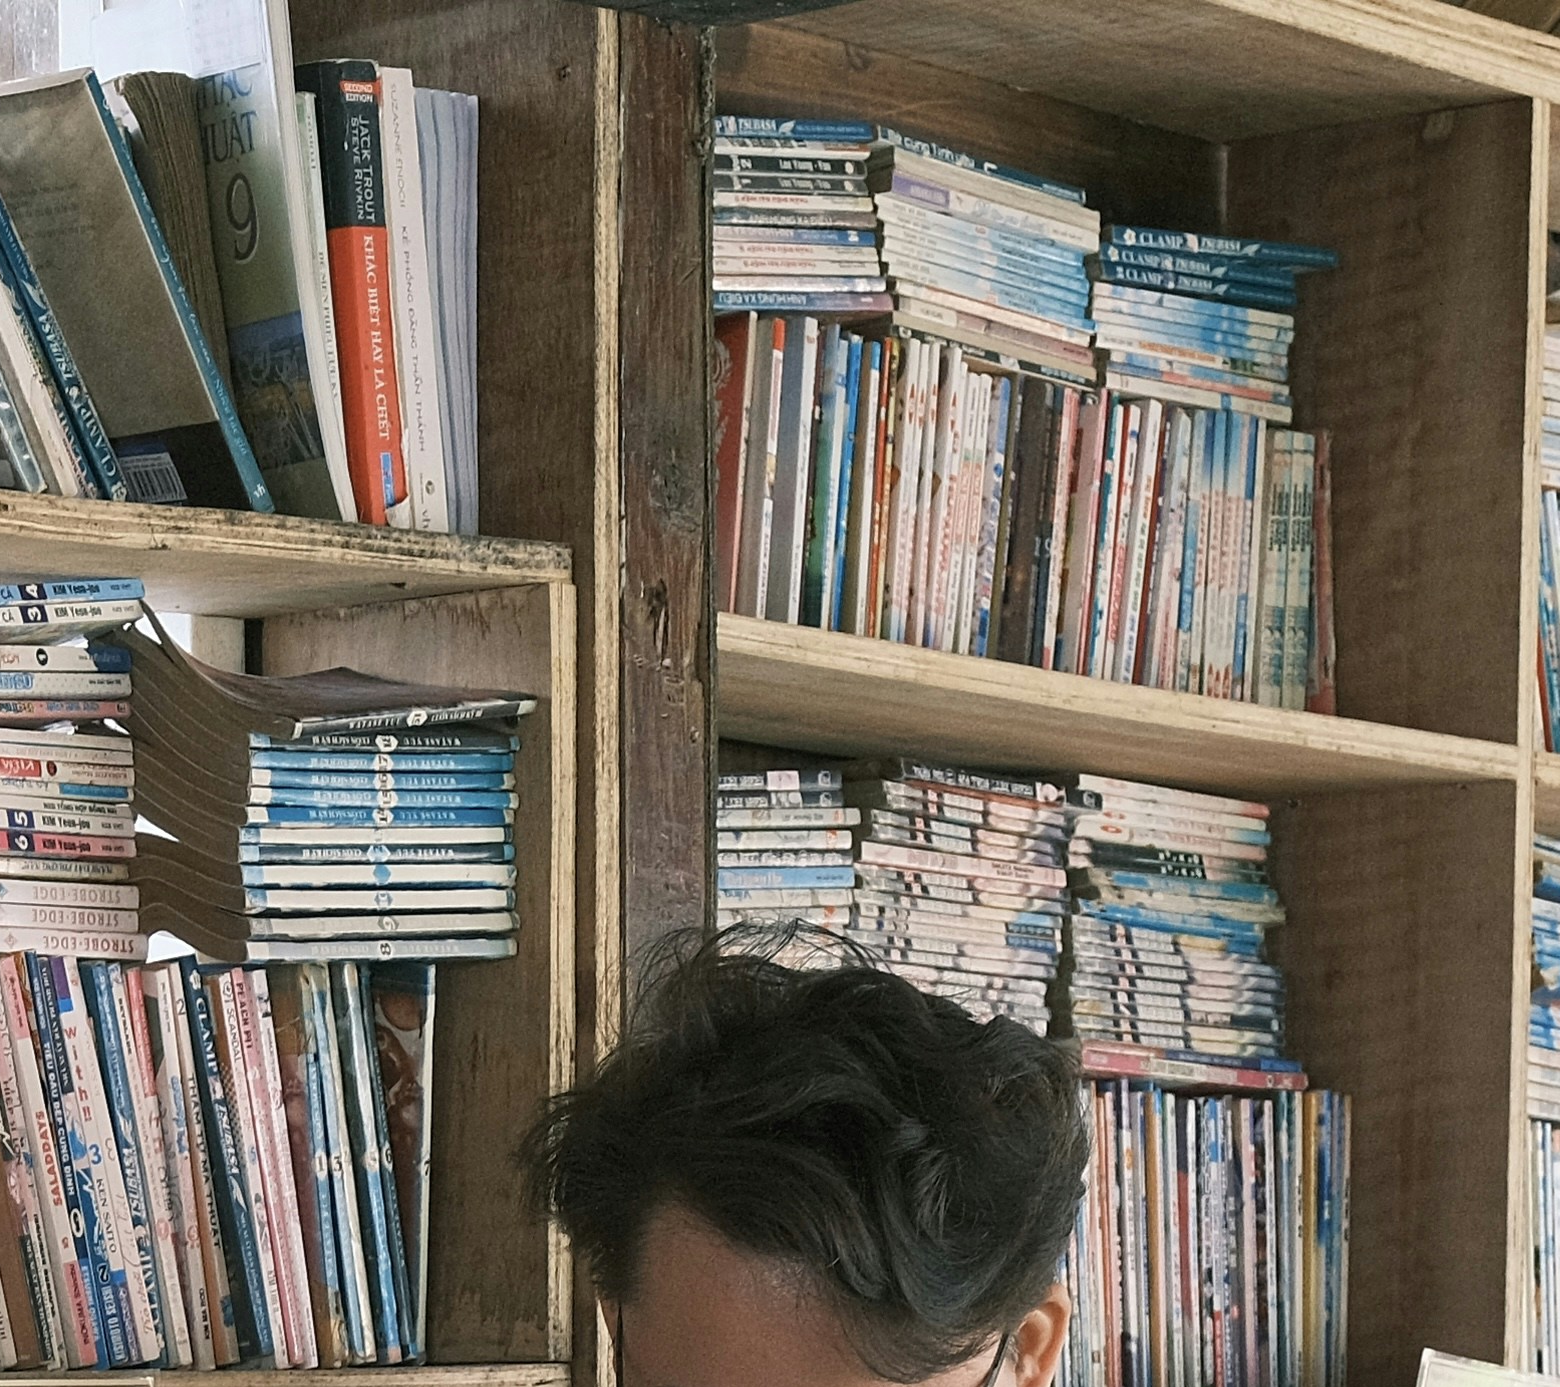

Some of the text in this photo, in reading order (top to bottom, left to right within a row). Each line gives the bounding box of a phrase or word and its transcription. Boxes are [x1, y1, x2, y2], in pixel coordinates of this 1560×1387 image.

[351, 117, 364, 220] STEVE RIVKIN
[359, 114, 375, 223] JACK TROUT
[226, 172, 259, 264] 9
[1139, 232, 1183, 250] CLAMP
[370, 330, 384, 364] HAY
